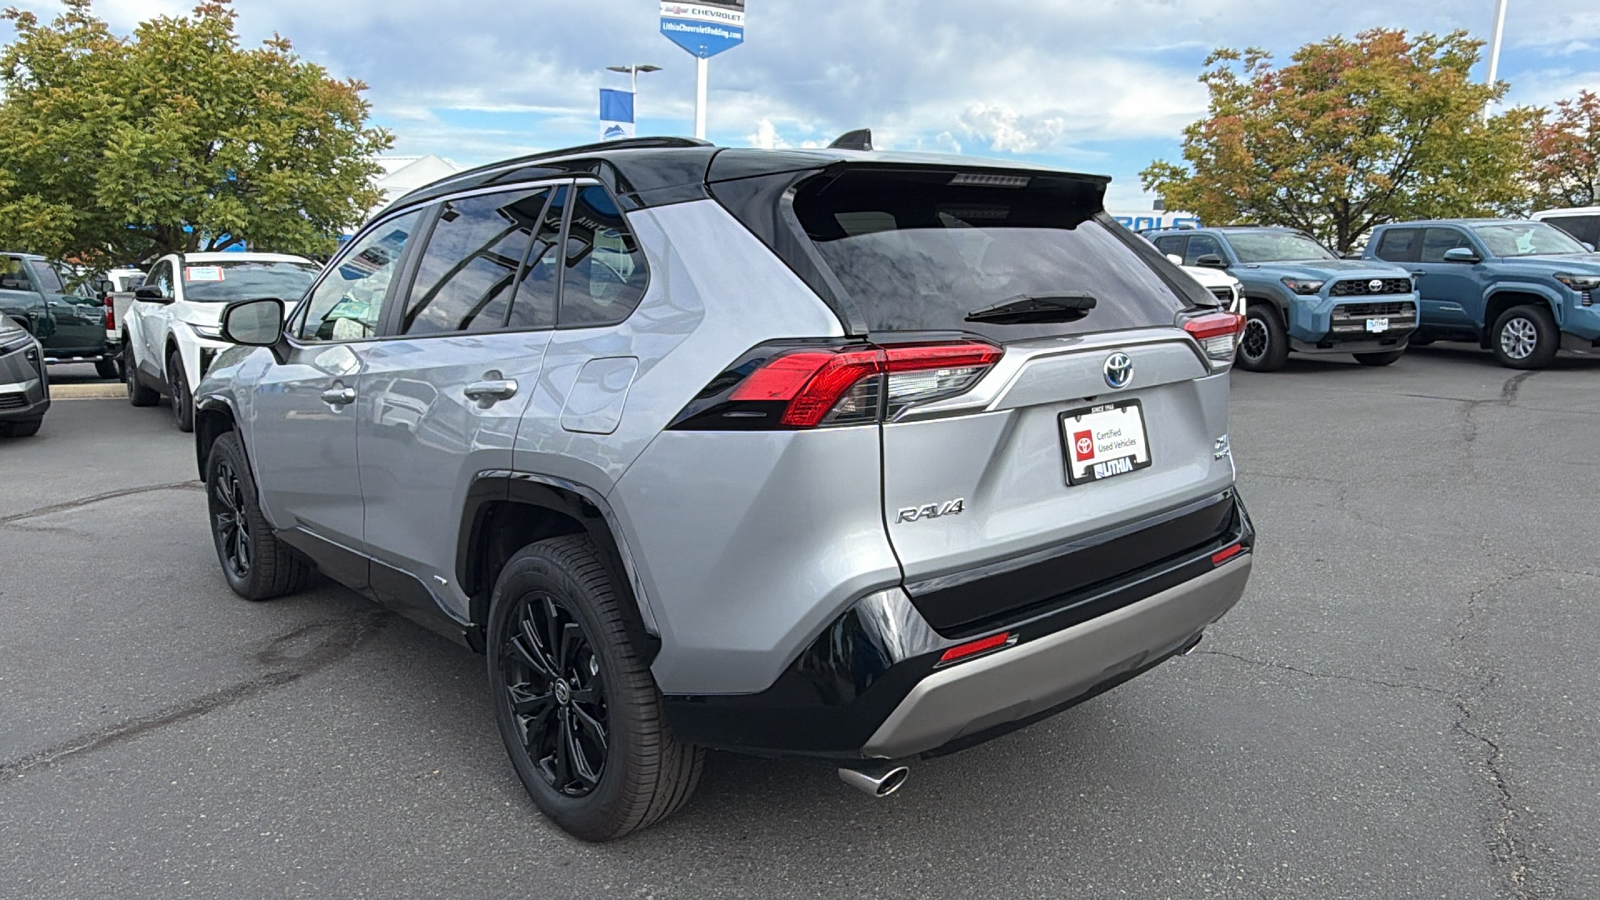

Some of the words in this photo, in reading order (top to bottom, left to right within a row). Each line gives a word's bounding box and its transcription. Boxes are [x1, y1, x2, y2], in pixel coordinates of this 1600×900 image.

[691, 8, 741, 21] CHEVROLET
[663, 22, 742, 39] LithiaChevroletRedding.com
[1091, 405, 1103, 414] SINCE
[1096, 428, 1122, 440] Certified
[1098, 442, 1113, 452] Used
[1113, 438, 1137, 449] Vehicles
[1102, 456, 1133, 477] LITHIA
[895, 498, 966, 524] RAV4
